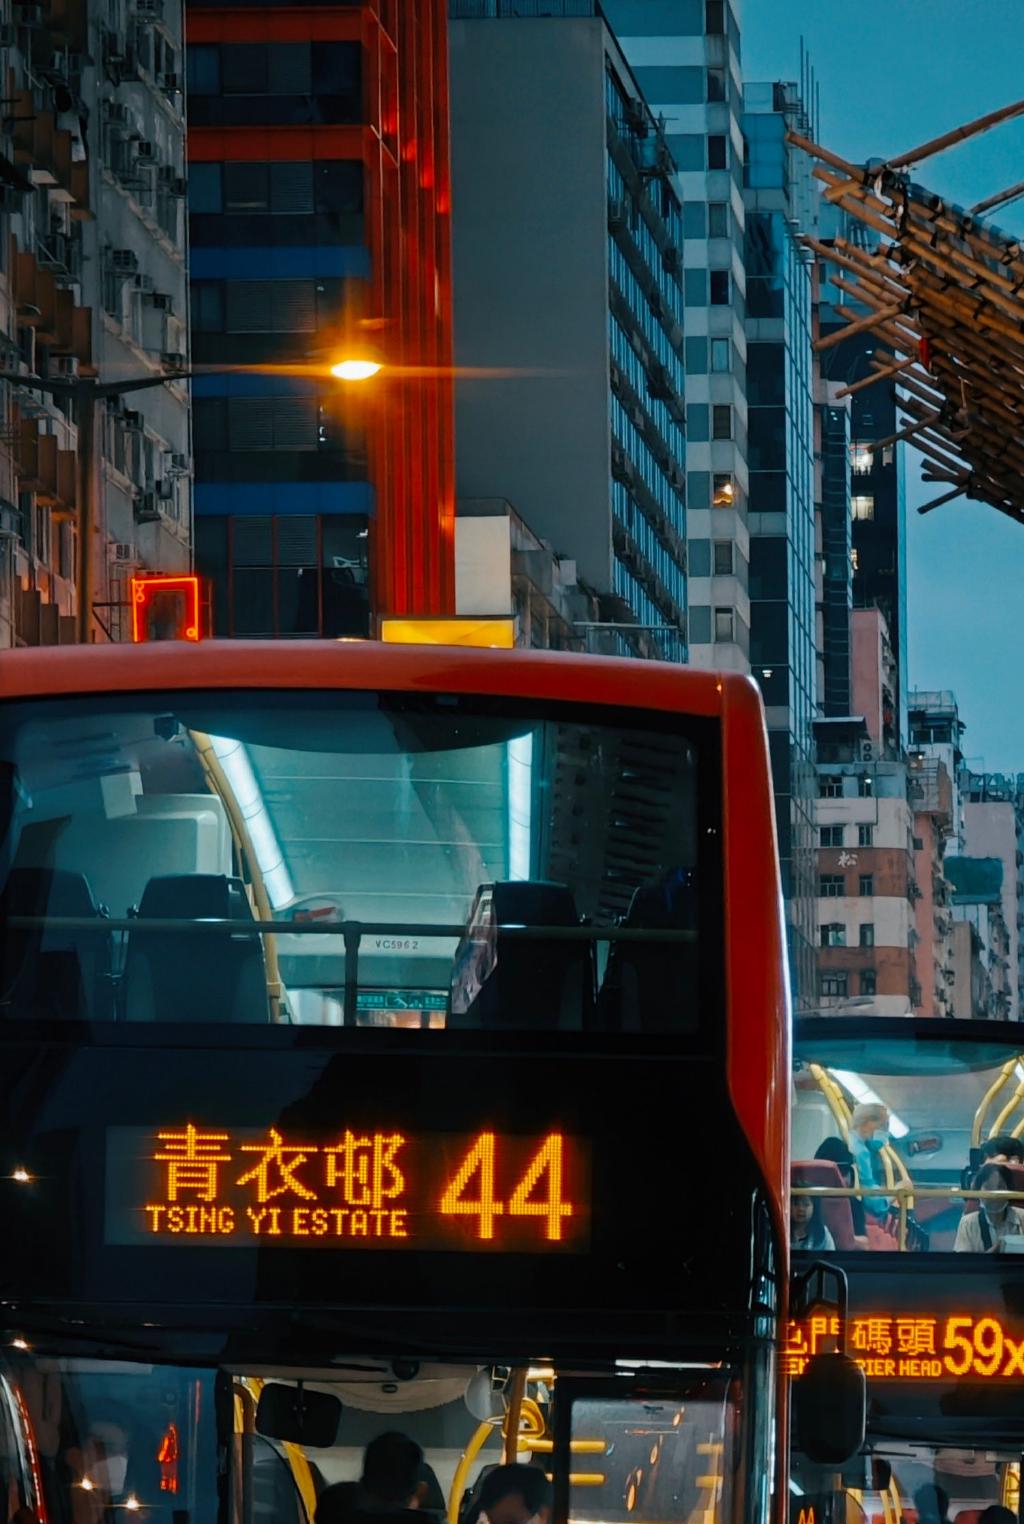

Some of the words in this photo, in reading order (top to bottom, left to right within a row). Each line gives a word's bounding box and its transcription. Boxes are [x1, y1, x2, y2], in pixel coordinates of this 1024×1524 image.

[375, 940, 419, 950] VC5962
[153, 1123, 406, 1208] 青衣邨
[439, 1131, 573, 1241] 44
[145, 1207, 235, 1235] TSING
[247, 1207, 283, 1235] YI
[292, 1207, 408, 1237] ESTATE
[899, 1360, 942, 1377] HEAD
